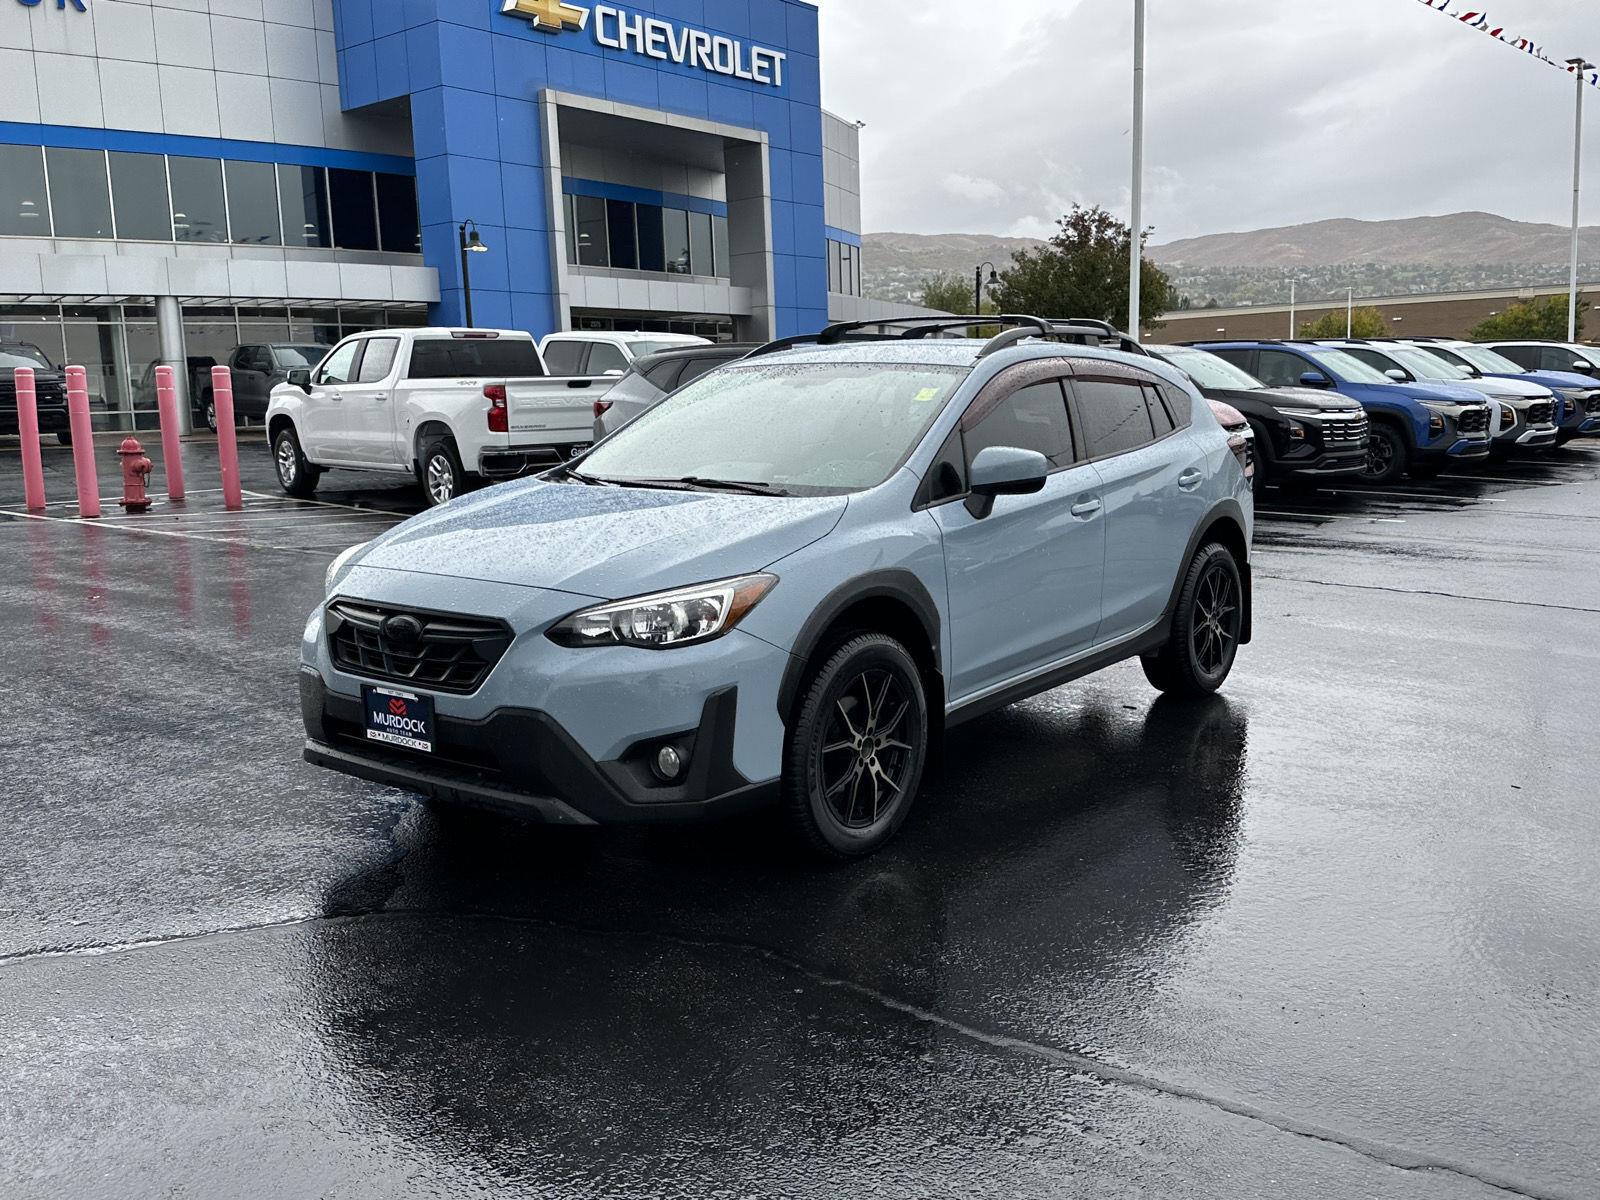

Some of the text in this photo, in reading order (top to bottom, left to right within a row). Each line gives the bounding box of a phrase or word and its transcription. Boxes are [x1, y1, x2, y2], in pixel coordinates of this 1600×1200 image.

[594, 4, 787, 87] CHEVROLET
[373, 711, 426, 734] MURDOCK
[381, 733, 417, 747] MURDOCK
